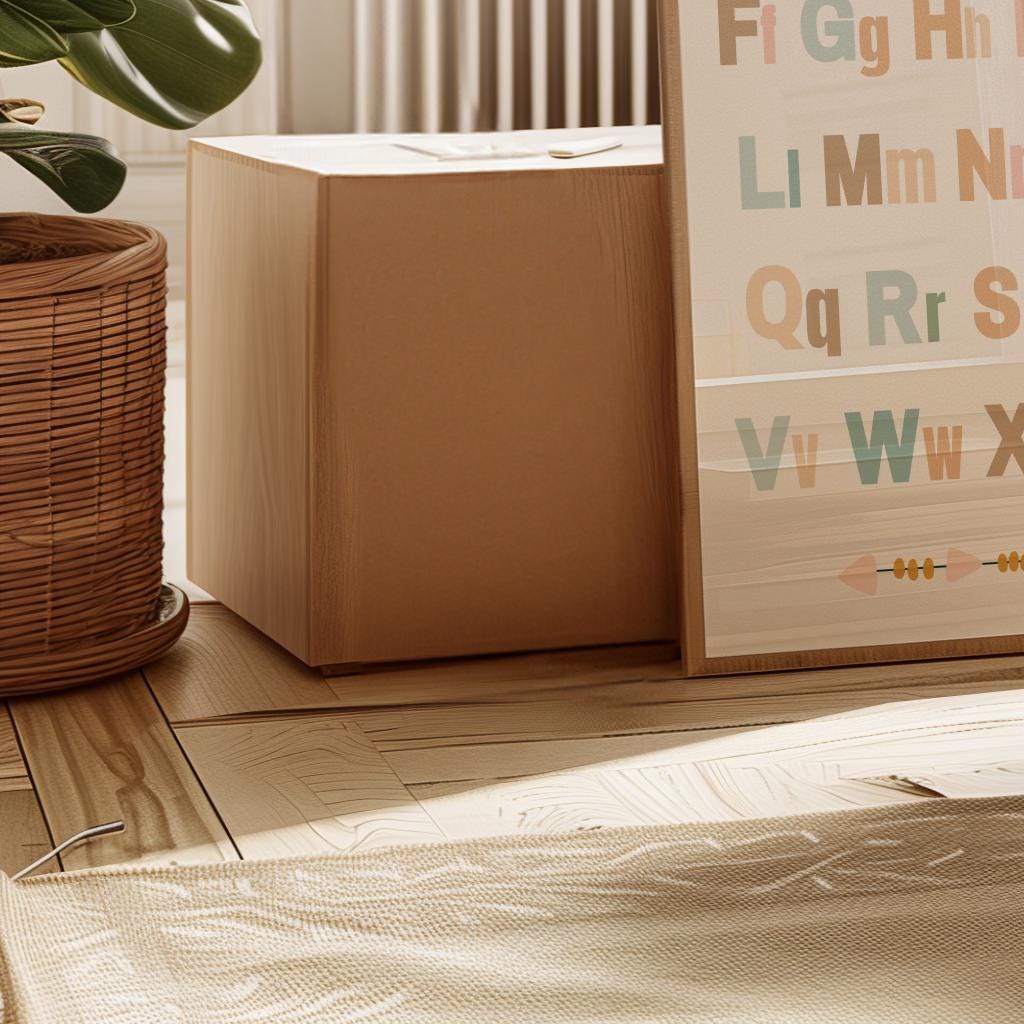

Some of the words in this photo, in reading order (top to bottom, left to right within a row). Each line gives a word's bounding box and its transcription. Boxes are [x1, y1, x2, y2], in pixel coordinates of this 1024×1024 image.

[738, 136, 800, 209] Ll
[823, 133, 936, 206] Mm
[745, 265, 841, 356] Qq
[865, 269, 946, 345] Rr
[734, 416, 818, 491] Vv
[844, 409, 962, 485] Ww
